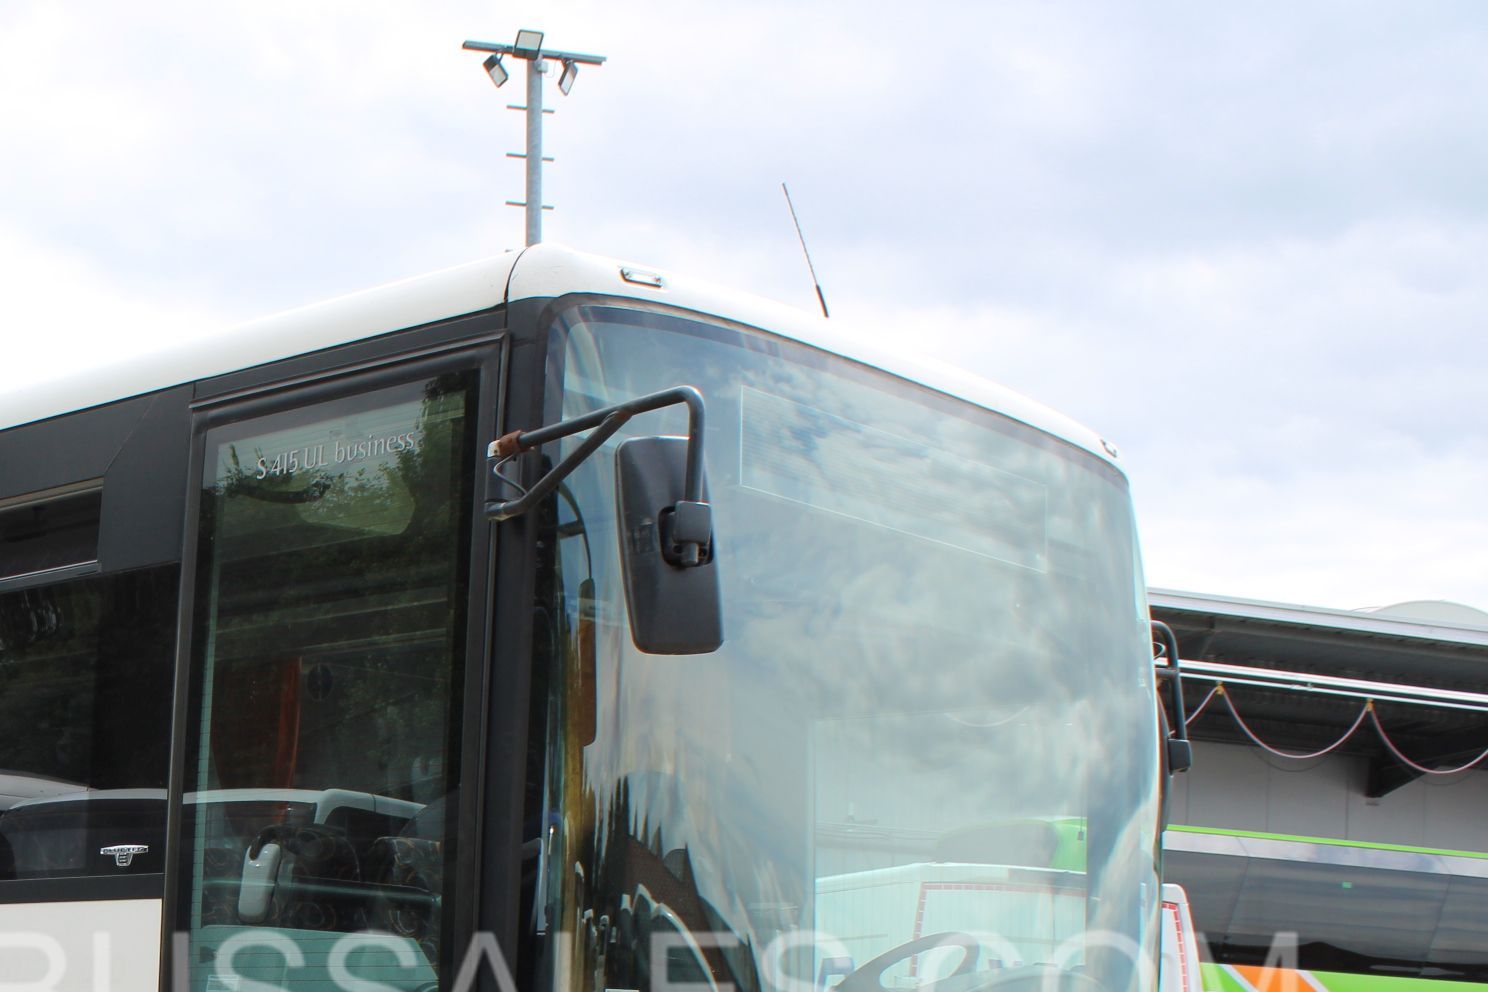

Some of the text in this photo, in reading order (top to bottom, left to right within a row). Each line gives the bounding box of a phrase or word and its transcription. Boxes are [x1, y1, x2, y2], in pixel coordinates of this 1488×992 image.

[255, 431, 415, 480] S 415 UL business
